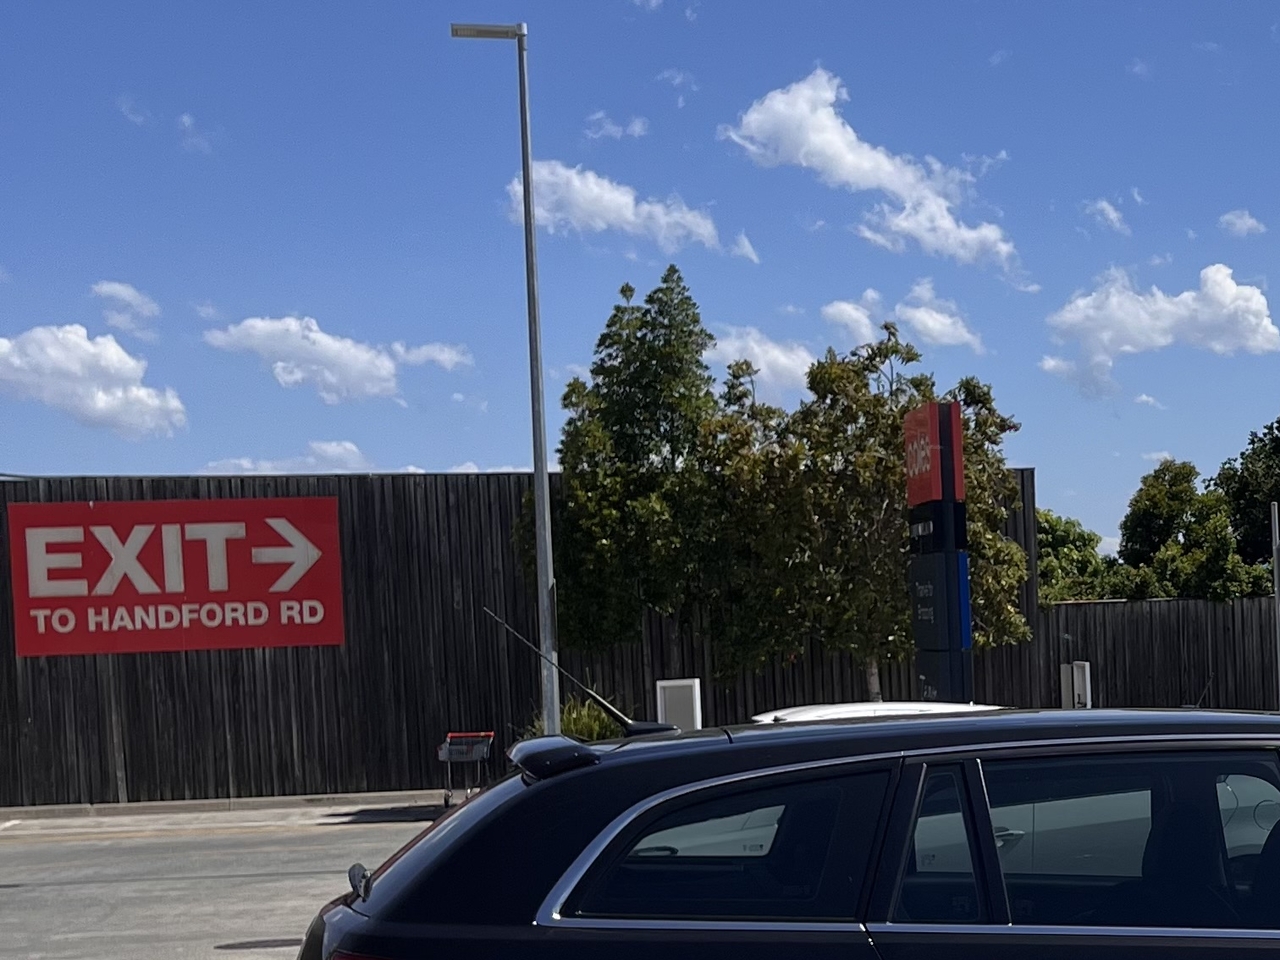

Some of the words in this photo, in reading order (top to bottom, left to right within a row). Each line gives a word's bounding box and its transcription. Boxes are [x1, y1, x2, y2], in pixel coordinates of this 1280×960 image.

[25, 522, 246, 598] EXIT
[30, 608, 76, 634] TO
[87, 601, 269, 632] HANDFORD
[280, 600, 325, 625] RD
